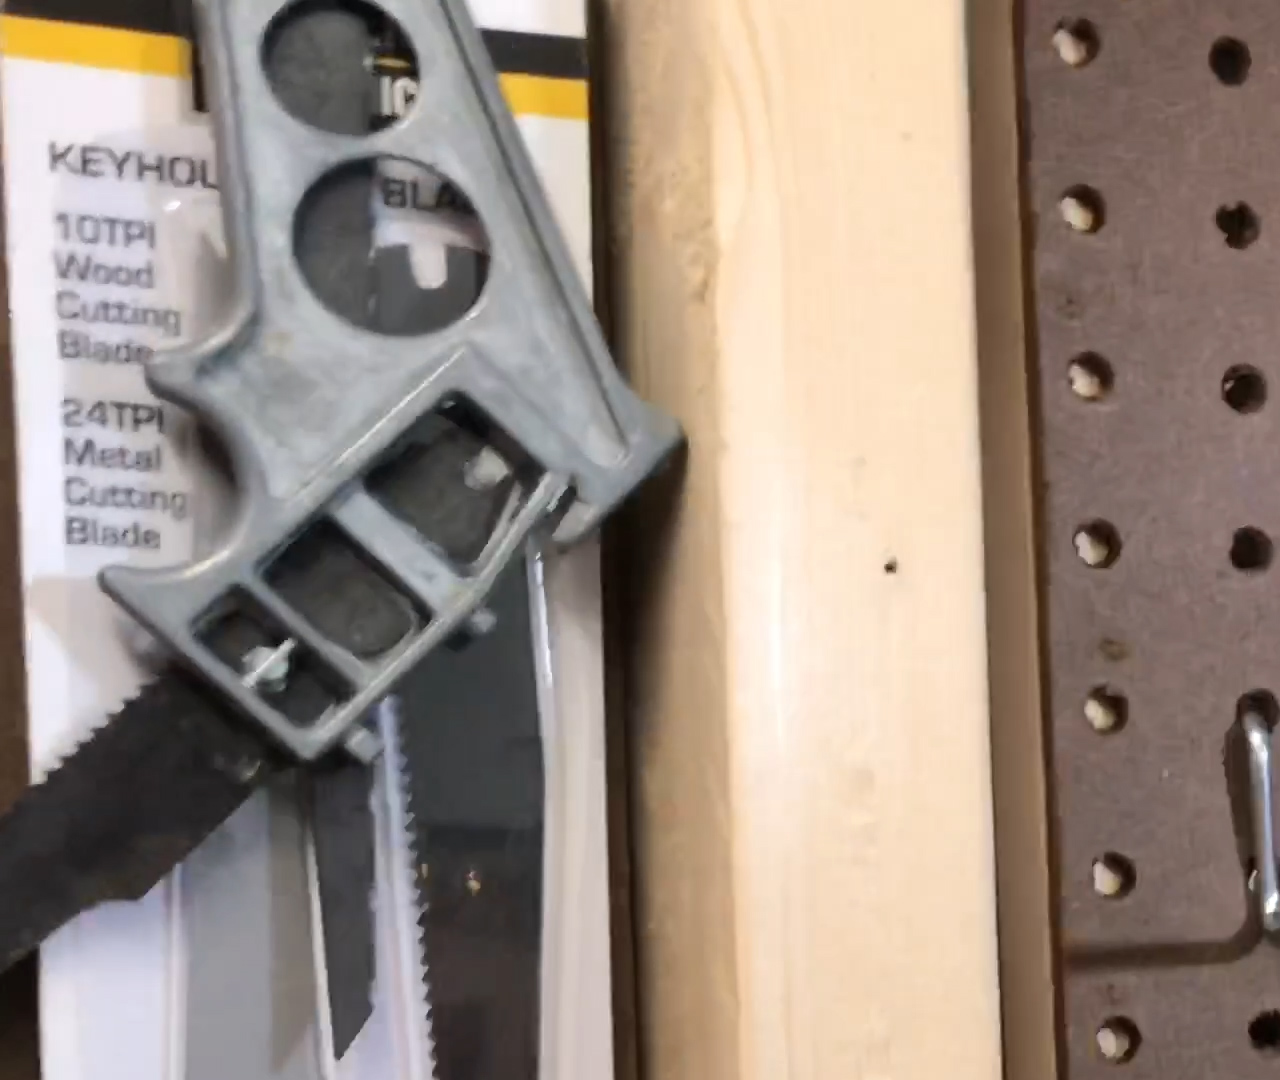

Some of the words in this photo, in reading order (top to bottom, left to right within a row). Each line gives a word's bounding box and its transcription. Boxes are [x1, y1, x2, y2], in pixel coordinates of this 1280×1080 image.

[56, 212, 155, 249] 10TPI
[54, 252, 154, 289] Wood
[56, 289, 182, 337] Cutting
[57, 329, 155, 364] Blade
[63, 398, 164, 435] 24TPI
[64, 437, 161, 472] Metal
[65, 476, 188, 520] Cutting
[66, 516, 161, 550] Blade
